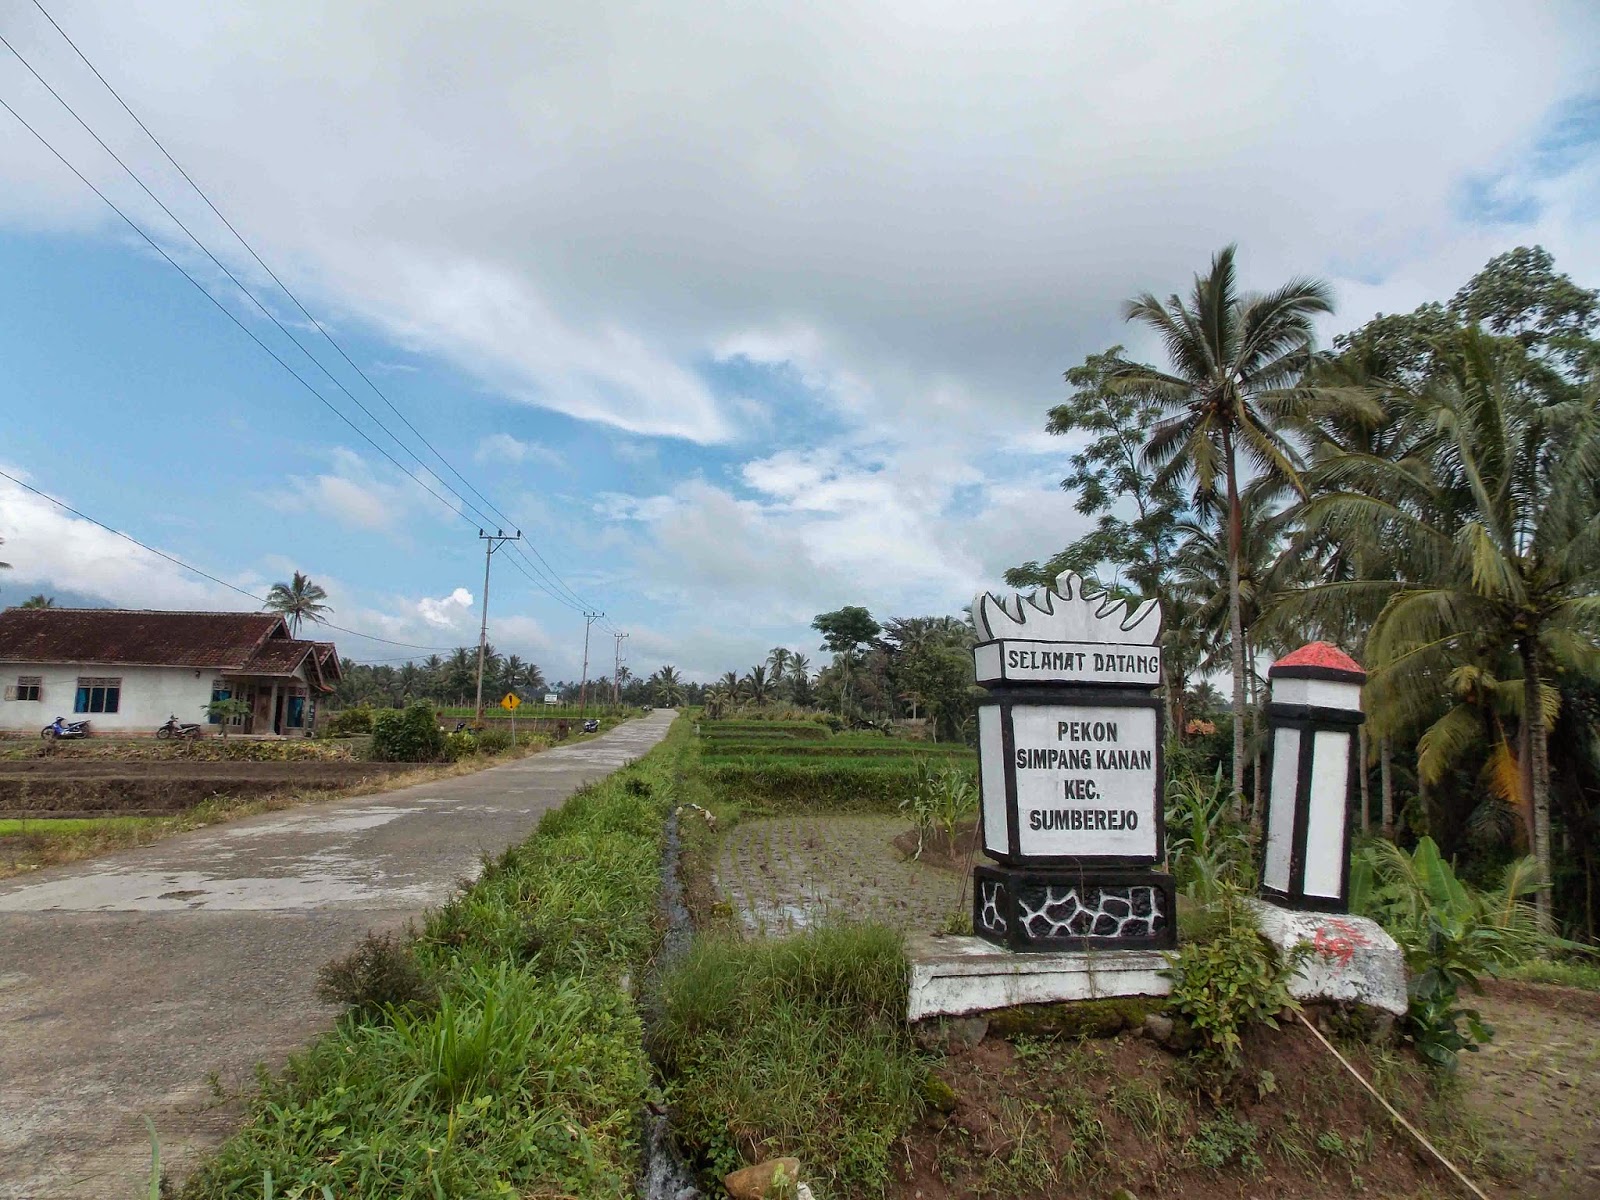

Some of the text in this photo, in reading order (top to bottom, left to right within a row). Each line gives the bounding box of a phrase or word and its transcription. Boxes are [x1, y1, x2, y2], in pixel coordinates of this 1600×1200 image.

[1008, 651, 1159, 674] SELAMAT DATANG
[1057, 721, 1118, 742] PEKON
[1016, 749, 1151, 770] SIMPANG KANAN
[1064, 779, 1100, 800] KEC.
[1029, 809, 1138, 831] SUMBEREJO
